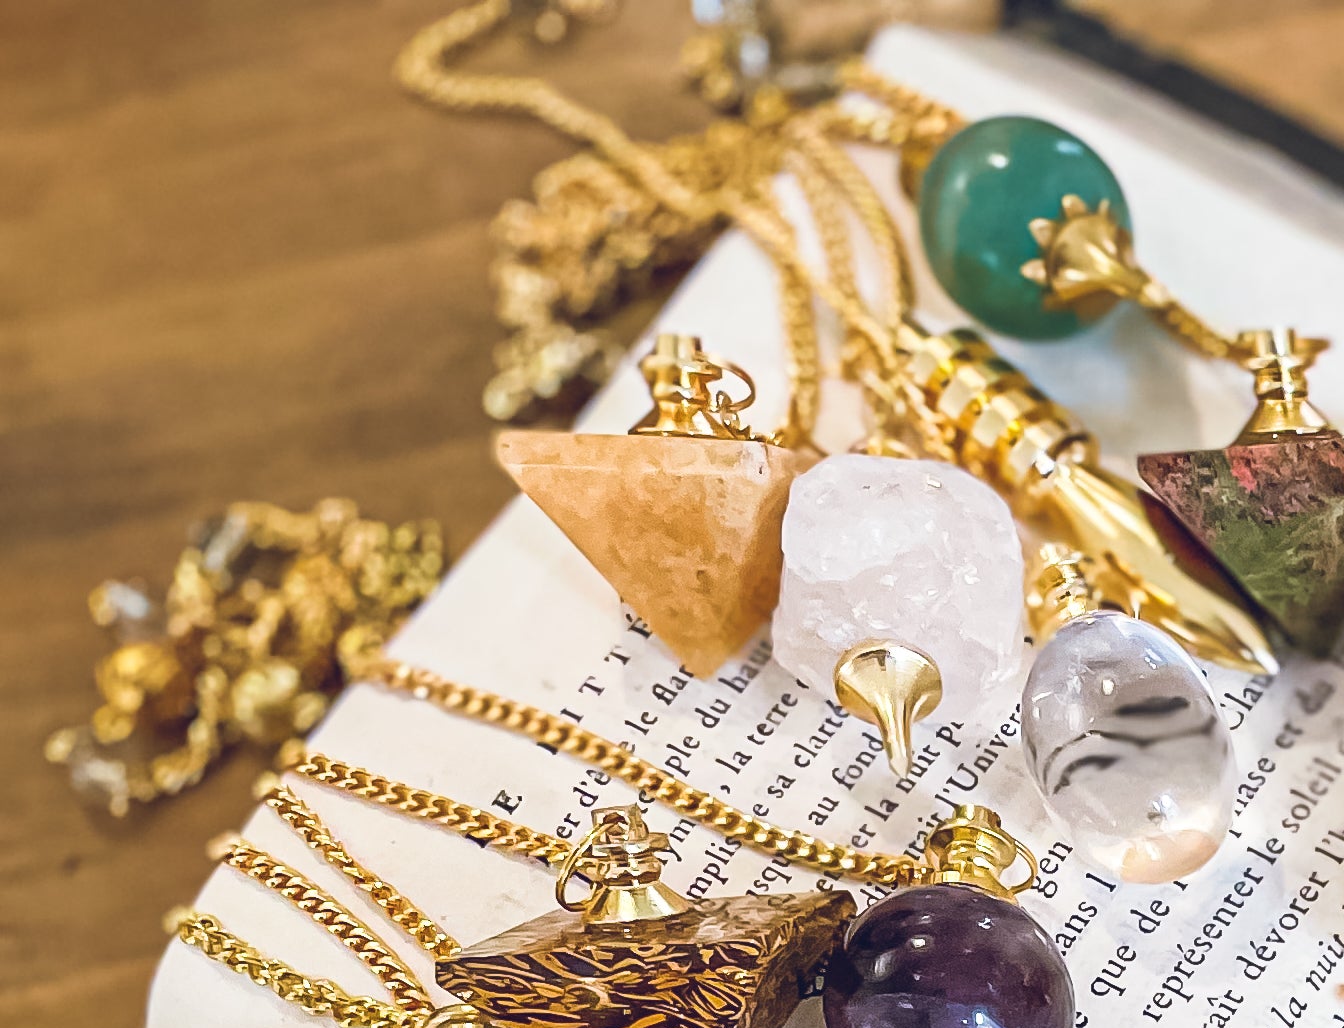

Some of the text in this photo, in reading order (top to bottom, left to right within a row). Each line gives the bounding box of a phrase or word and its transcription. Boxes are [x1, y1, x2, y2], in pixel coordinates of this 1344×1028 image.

[623, 710, 660, 737] le
[693, 697, 733, 730] du
[713, 692, 800, 776] la terre
[766, 773, 797, 800] sa
[806, 795, 841, 827] au
[862, 797, 901, 824] la
[1141, 865, 1265, 1024] représenter
[1245, 836, 1287, 867] le
[1234, 870, 1331, 982] dévorer
[1089, 898, 1172, 998] que de
